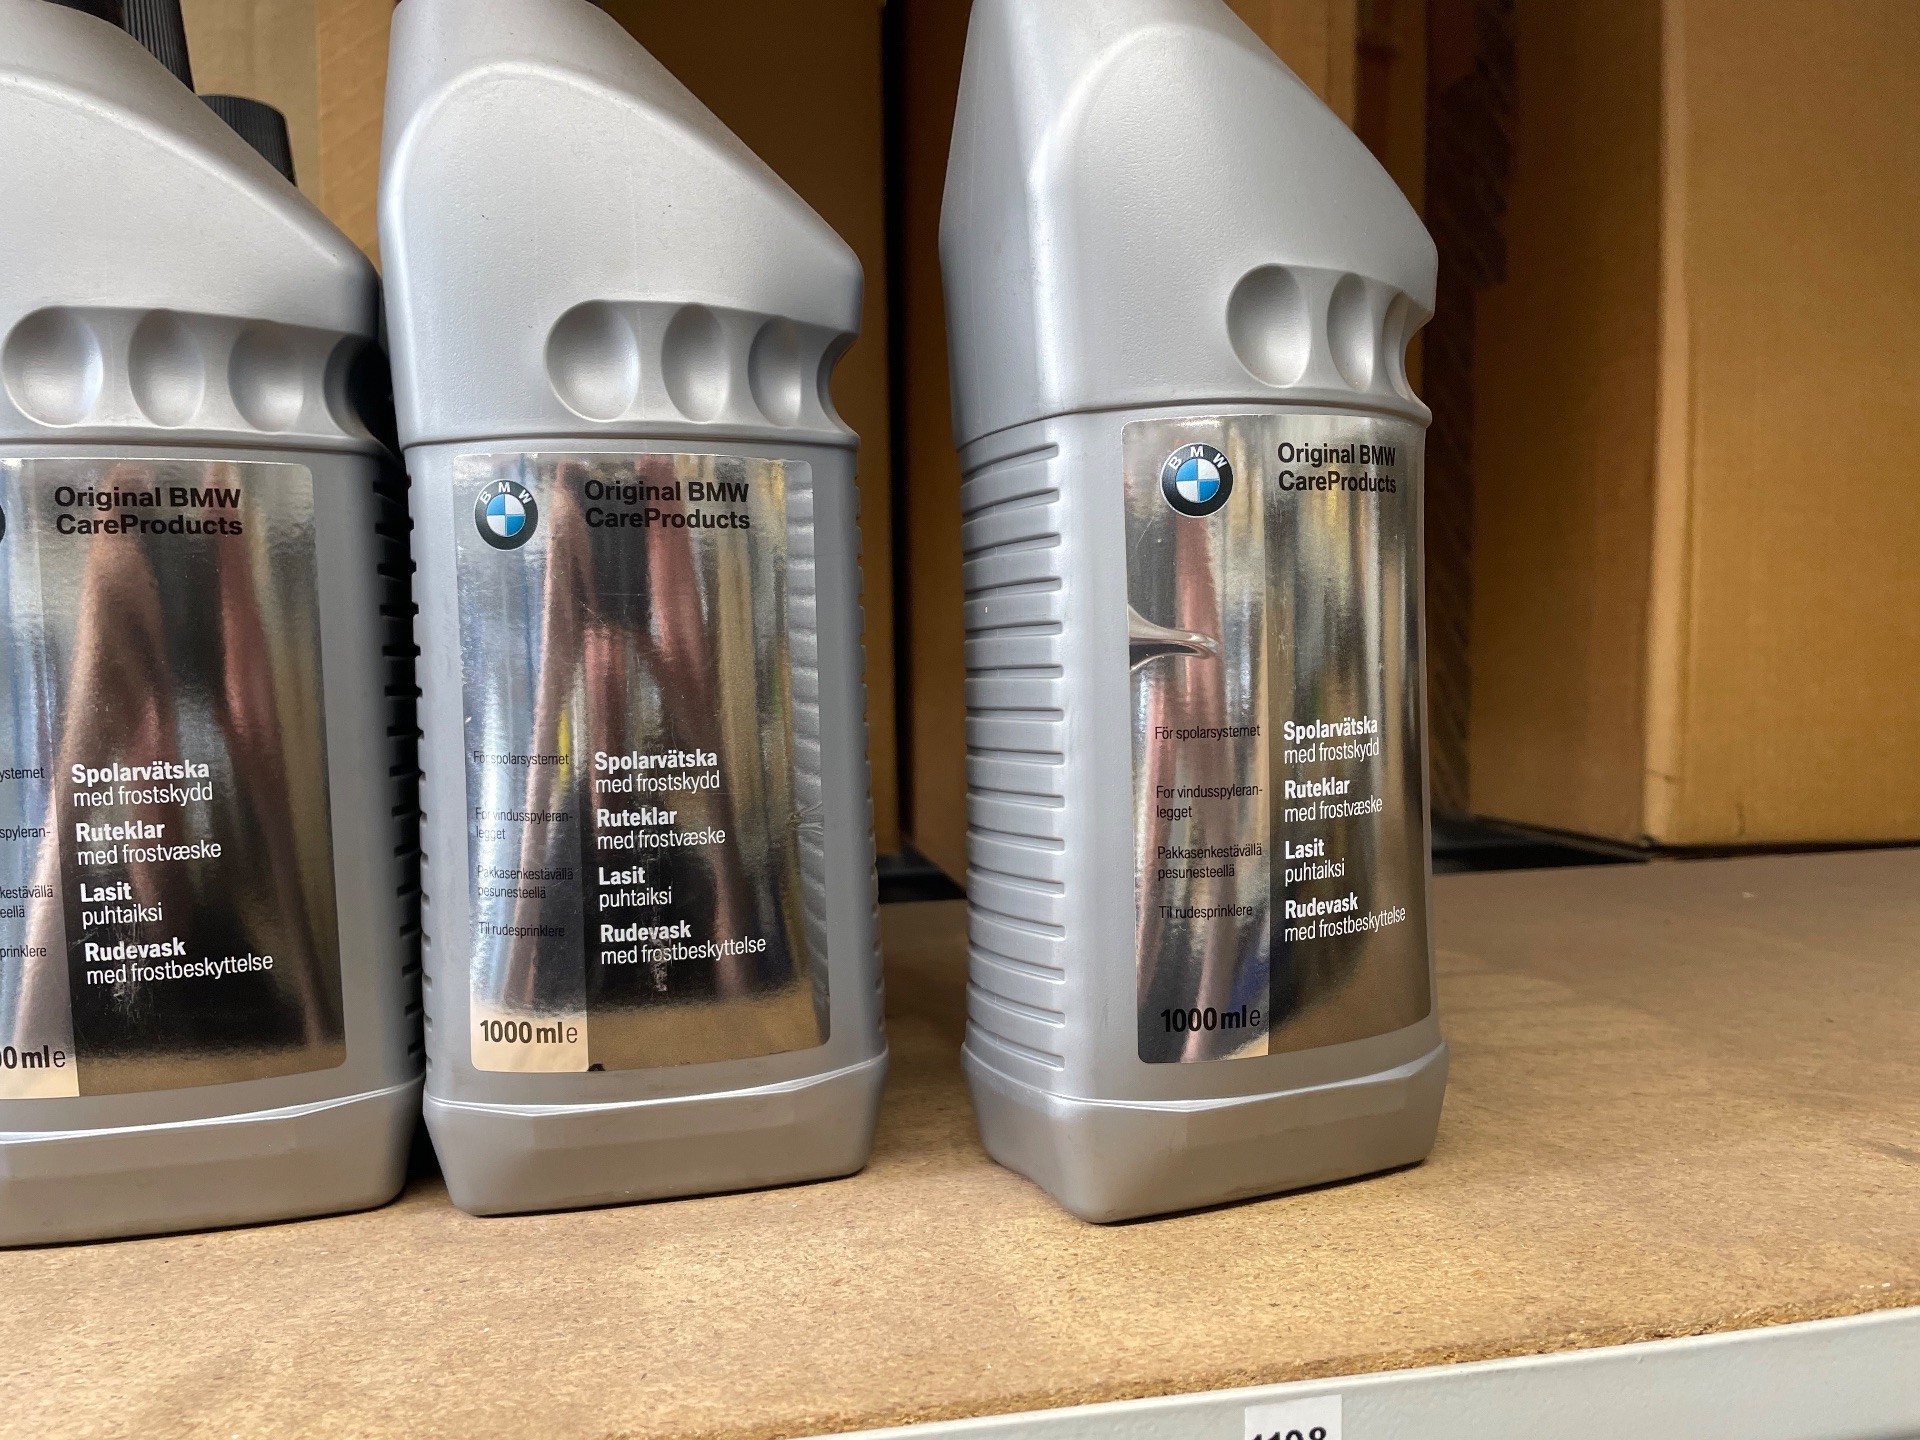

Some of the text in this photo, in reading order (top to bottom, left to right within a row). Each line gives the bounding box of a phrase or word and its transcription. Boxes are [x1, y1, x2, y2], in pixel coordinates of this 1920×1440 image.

[1168, 446, 1228, 469] BMW
[1278, 443, 1396, 467] Original BMW
[585, 480, 749, 504] Original BMW
[1279, 470, 1396, 493] CareProducts
[54, 486, 241, 511] Original BMW
[479, 482, 532, 505] BMW
[56, 514, 243, 535] CareProducts
[585, 508, 750, 529] CareProducts
[1155, 725, 1261, 742] För spolarsystemet
[1284, 716, 1378, 742] Spolarvätska
[491, 752, 569, 766] spolarsystemet
[595, 750, 718, 773] Spolarvätska
[1285, 738, 1379, 764] med frostskydd
[72, 760, 209, 787] Spolarvätska
[596, 771, 720, 795] med frostskydd
[74, 782, 213, 808] med frostskydd
[1156, 783, 1263, 800] For vindusspyleran-
[1285, 777, 1350, 800] Ruteklar
[597, 808, 677, 827] Ruteklar
[1156, 805, 1192, 820] legget
[1285, 795, 1382, 822] med frostvæske
[76, 821, 165, 842] Ruteklar
[476, 826, 506, 841] legget
[598, 829, 725, 849] med frostvæske
[77, 841, 221, 865] med frostvæske
[1158, 843, 1262, 859] Pakkasenkestävällä
[1285, 838, 1324, 860] Lasit
[477, 865, 574, 880] Pakkasenkestävällä
[599, 866, 645, 885] Lasit
[1158, 865, 1235, 880] pesunesteellä
[1285, 858, 1345, 887] puhtaiksi
[80, 881, 132, 902] Lasit
[478, 886, 546, 900] pesunesteellä
[599, 887, 672, 911] puhtaiksi
[82, 903, 163, 929] puhtaiksi
[1159, 905, 1253, 920] Til rudesprinklere
[1285, 893, 1358, 919] Rudevask
[479, 922, 565, 938] Til rudesprinklere
[600, 921, 691, 942] Rudevask
[1285, 906, 1406, 942] med frostbeskyttelse
[85, 938, 186, 961] Rudevask
[601, 936, 766, 964] med frostbeskyttelse
[87, 954, 273, 984] med frostbeskyttelse
[1161, 1007, 1217, 1032] 1000
[480, 1020, 532, 1044] 1000
